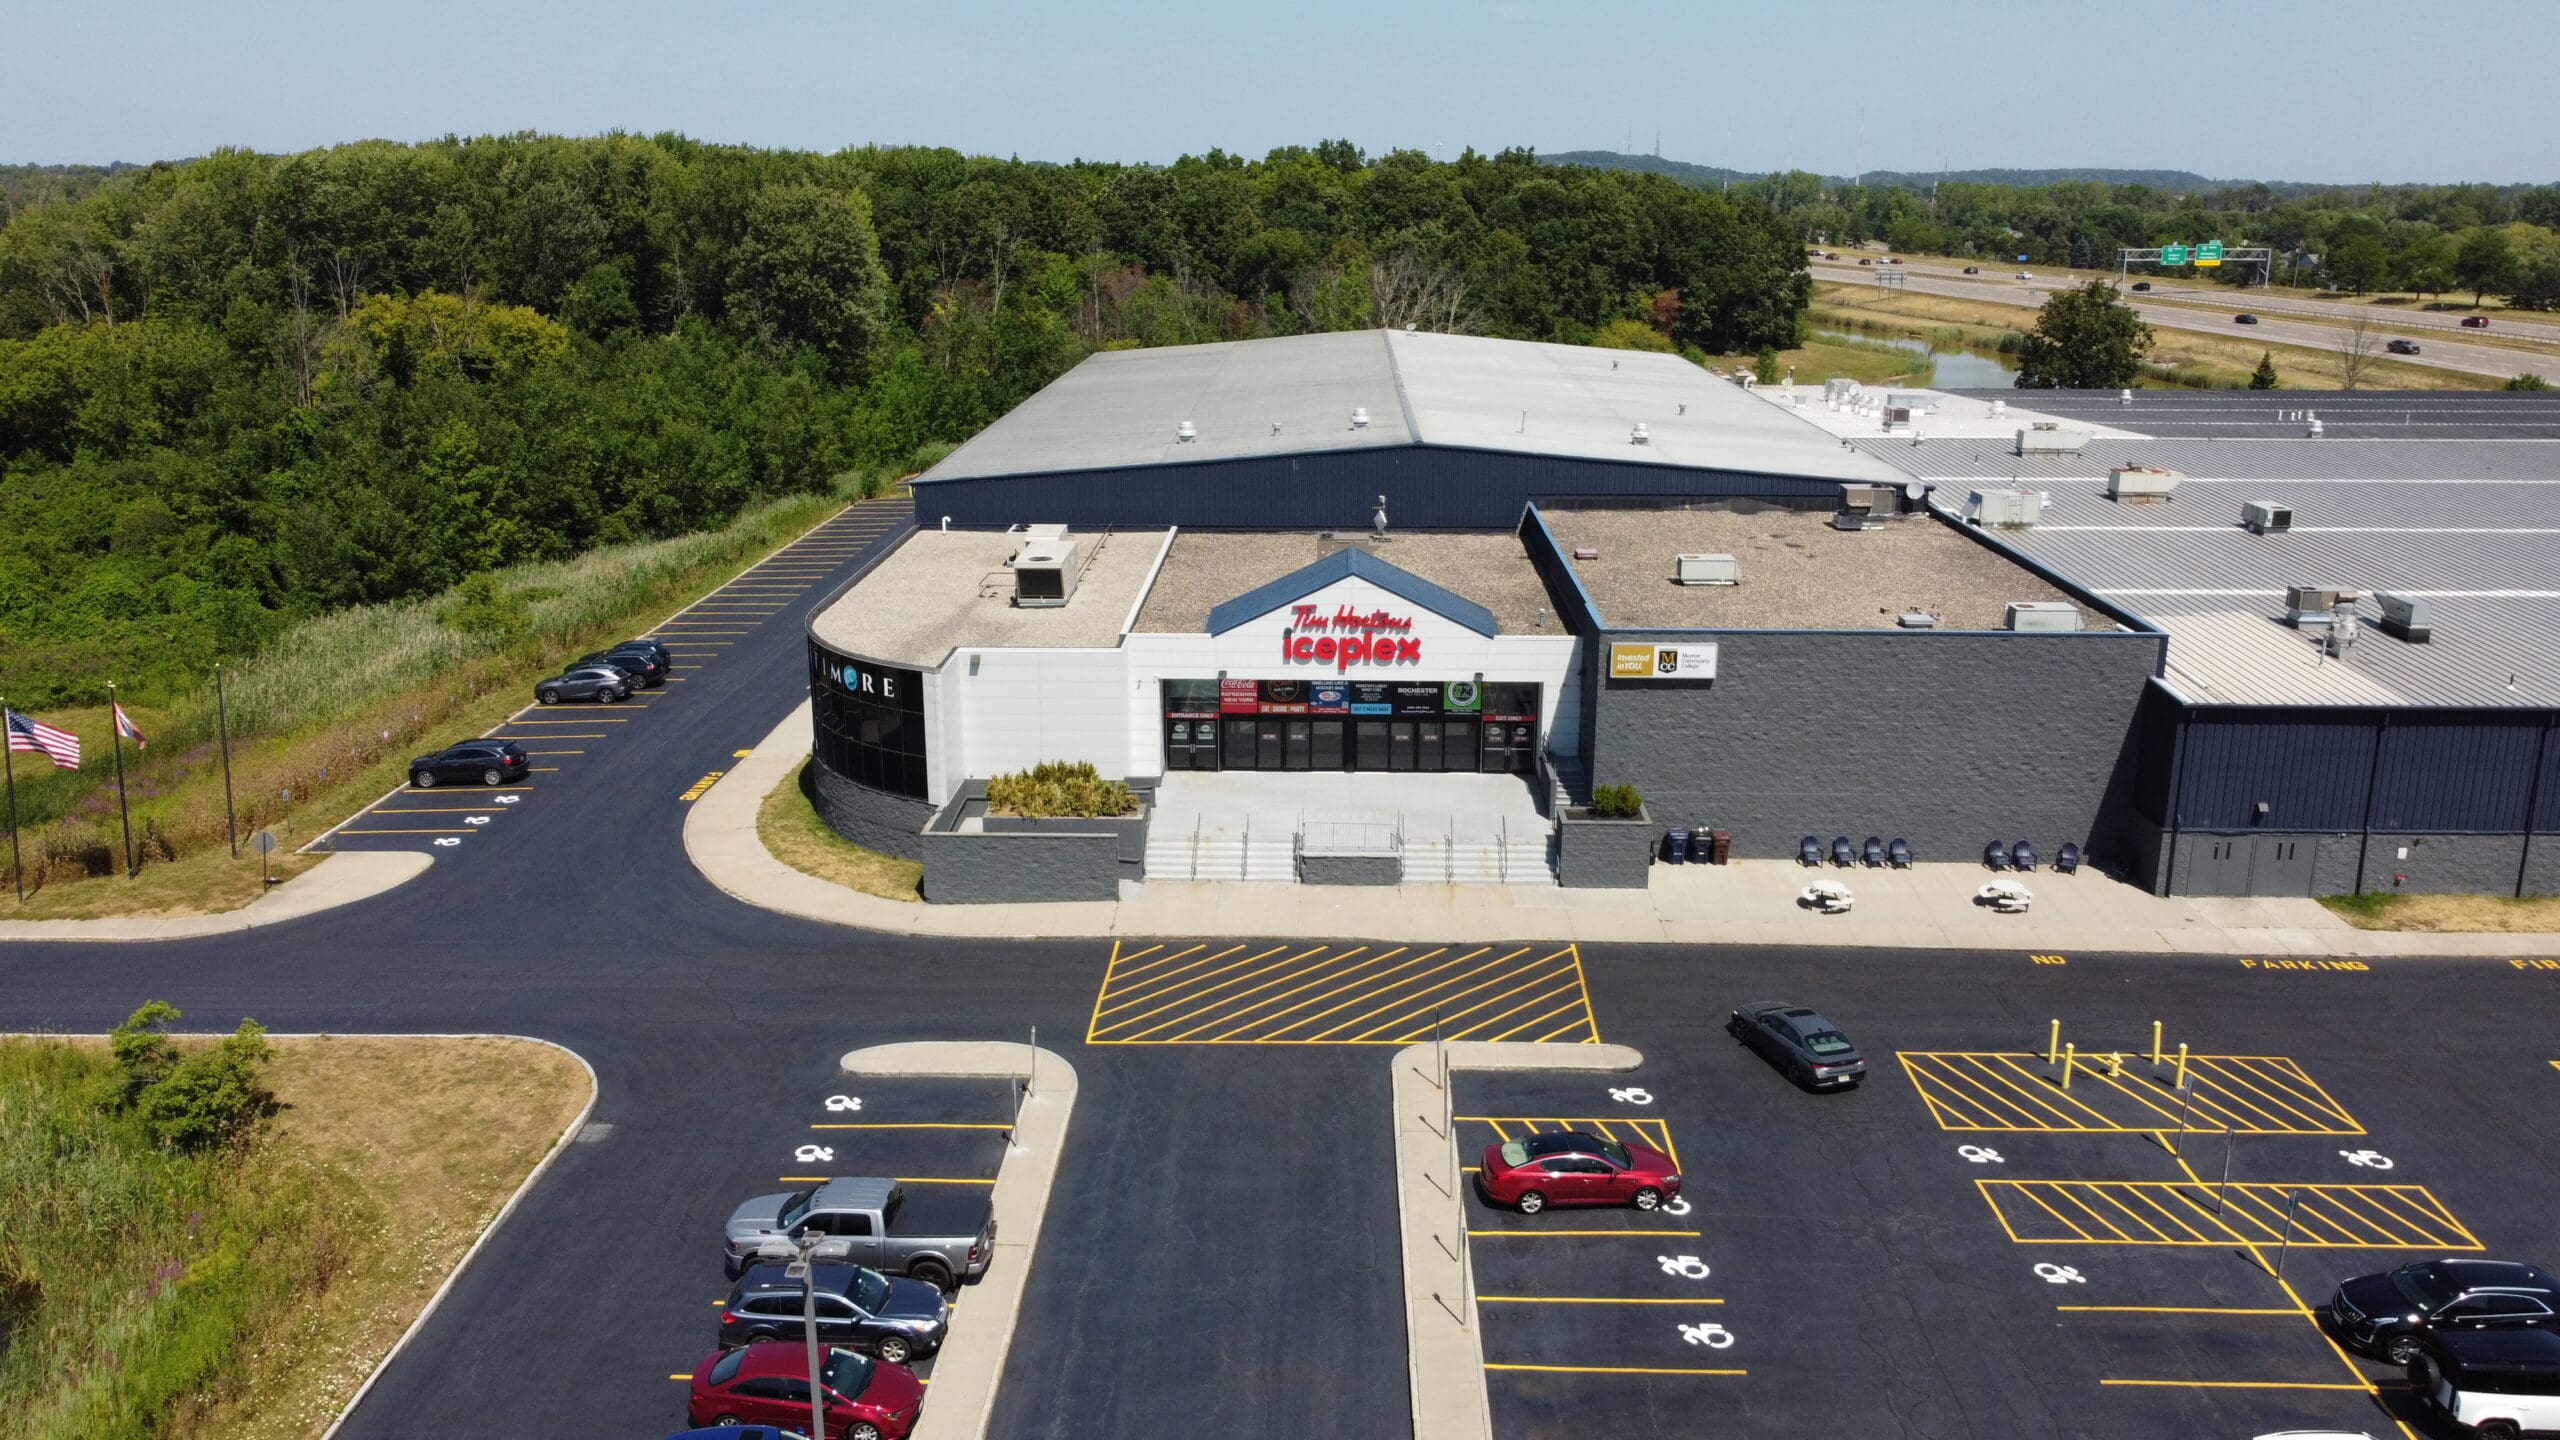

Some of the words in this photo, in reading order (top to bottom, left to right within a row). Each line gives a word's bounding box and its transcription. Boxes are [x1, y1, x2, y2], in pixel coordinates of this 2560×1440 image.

[1292, 604, 1329, 629] Tim
[1333, 604, 1412, 629] Hortons
[1284, 628, 1421, 671] iceplex
[1617, 654, 1650, 662] Invested
[2030, 955, 2067, 967] NO
[2240, 959, 2371, 972] PARKING
